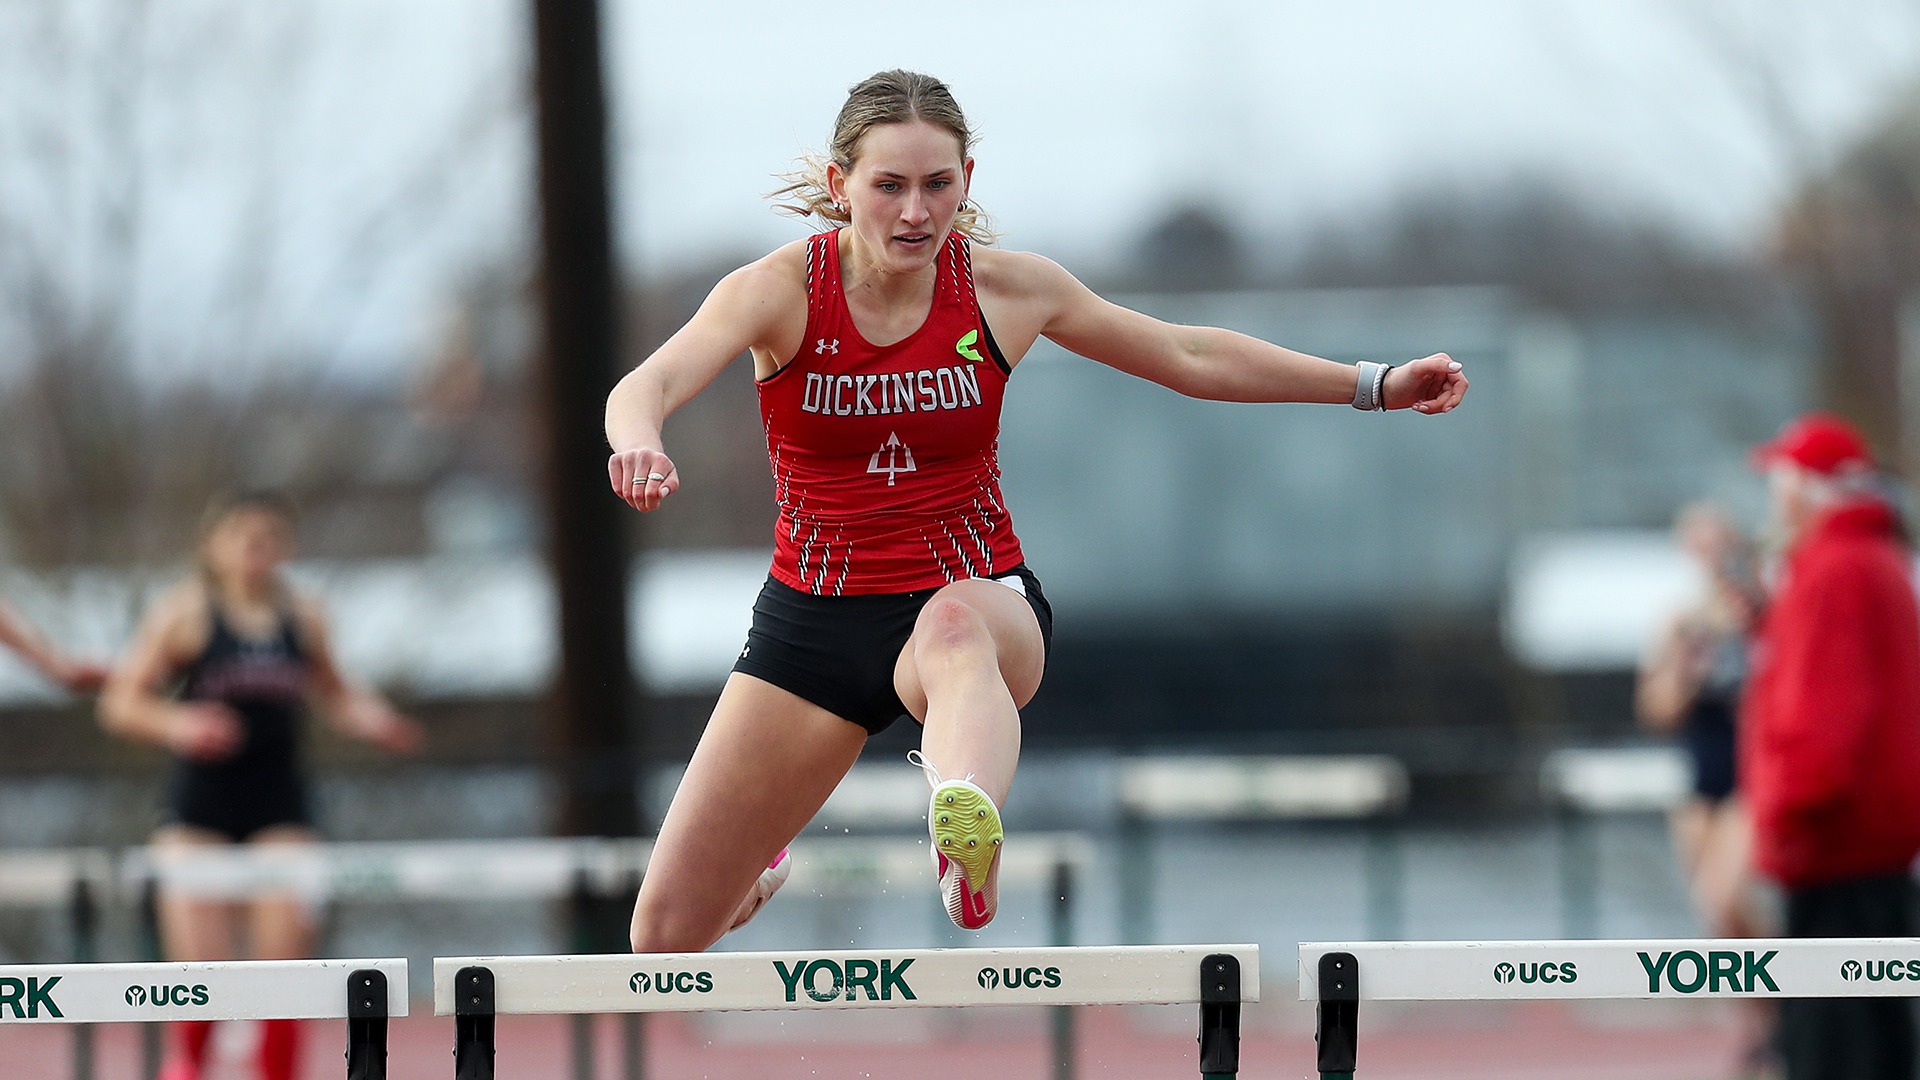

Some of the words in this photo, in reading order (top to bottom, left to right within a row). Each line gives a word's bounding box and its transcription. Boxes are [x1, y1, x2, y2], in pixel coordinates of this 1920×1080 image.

[802, 364, 982, 416] DICKINSON
[655, 971, 714, 994] UCS
[773, 958, 917, 1003] YORK
[1003, 966, 1062, 989] UCS
[1519, 962, 1578, 984] UCS
[1637, 950, 1780, 994] YORK
[1866, 959, 1920, 982] UCS
[150, 983, 209, 1007] UCS
